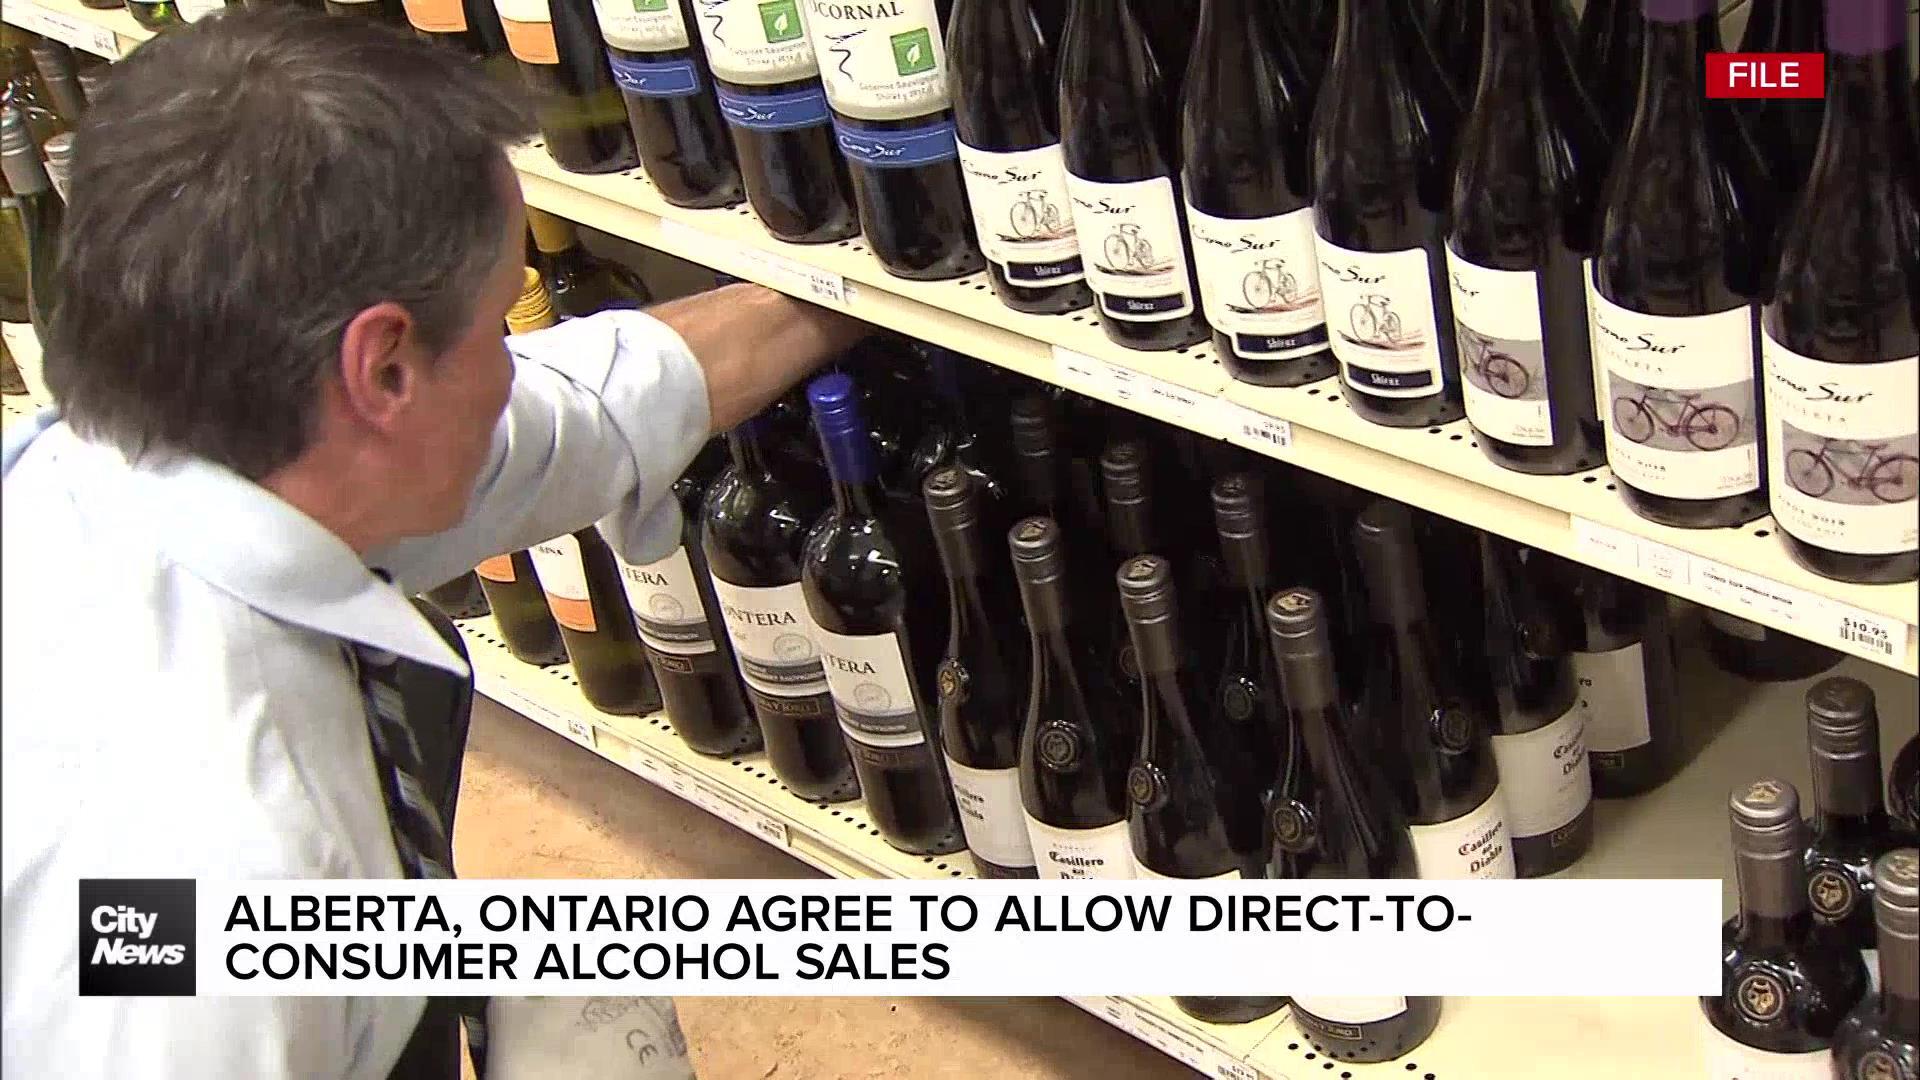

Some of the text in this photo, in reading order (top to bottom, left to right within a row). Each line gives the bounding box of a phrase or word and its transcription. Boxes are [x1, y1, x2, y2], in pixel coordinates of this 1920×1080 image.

[998, 165, 1043, 185] Sur
[1093, 197, 1137, 214] Sur
[1231, 233, 1281, 254] Sur
[1339, 265, 1386, 284] Sur
[1626, 332, 1687, 355] Sur
[1370, 372, 1401, 386] Shiraz
[1805, 382, 1874, 403] Sur
